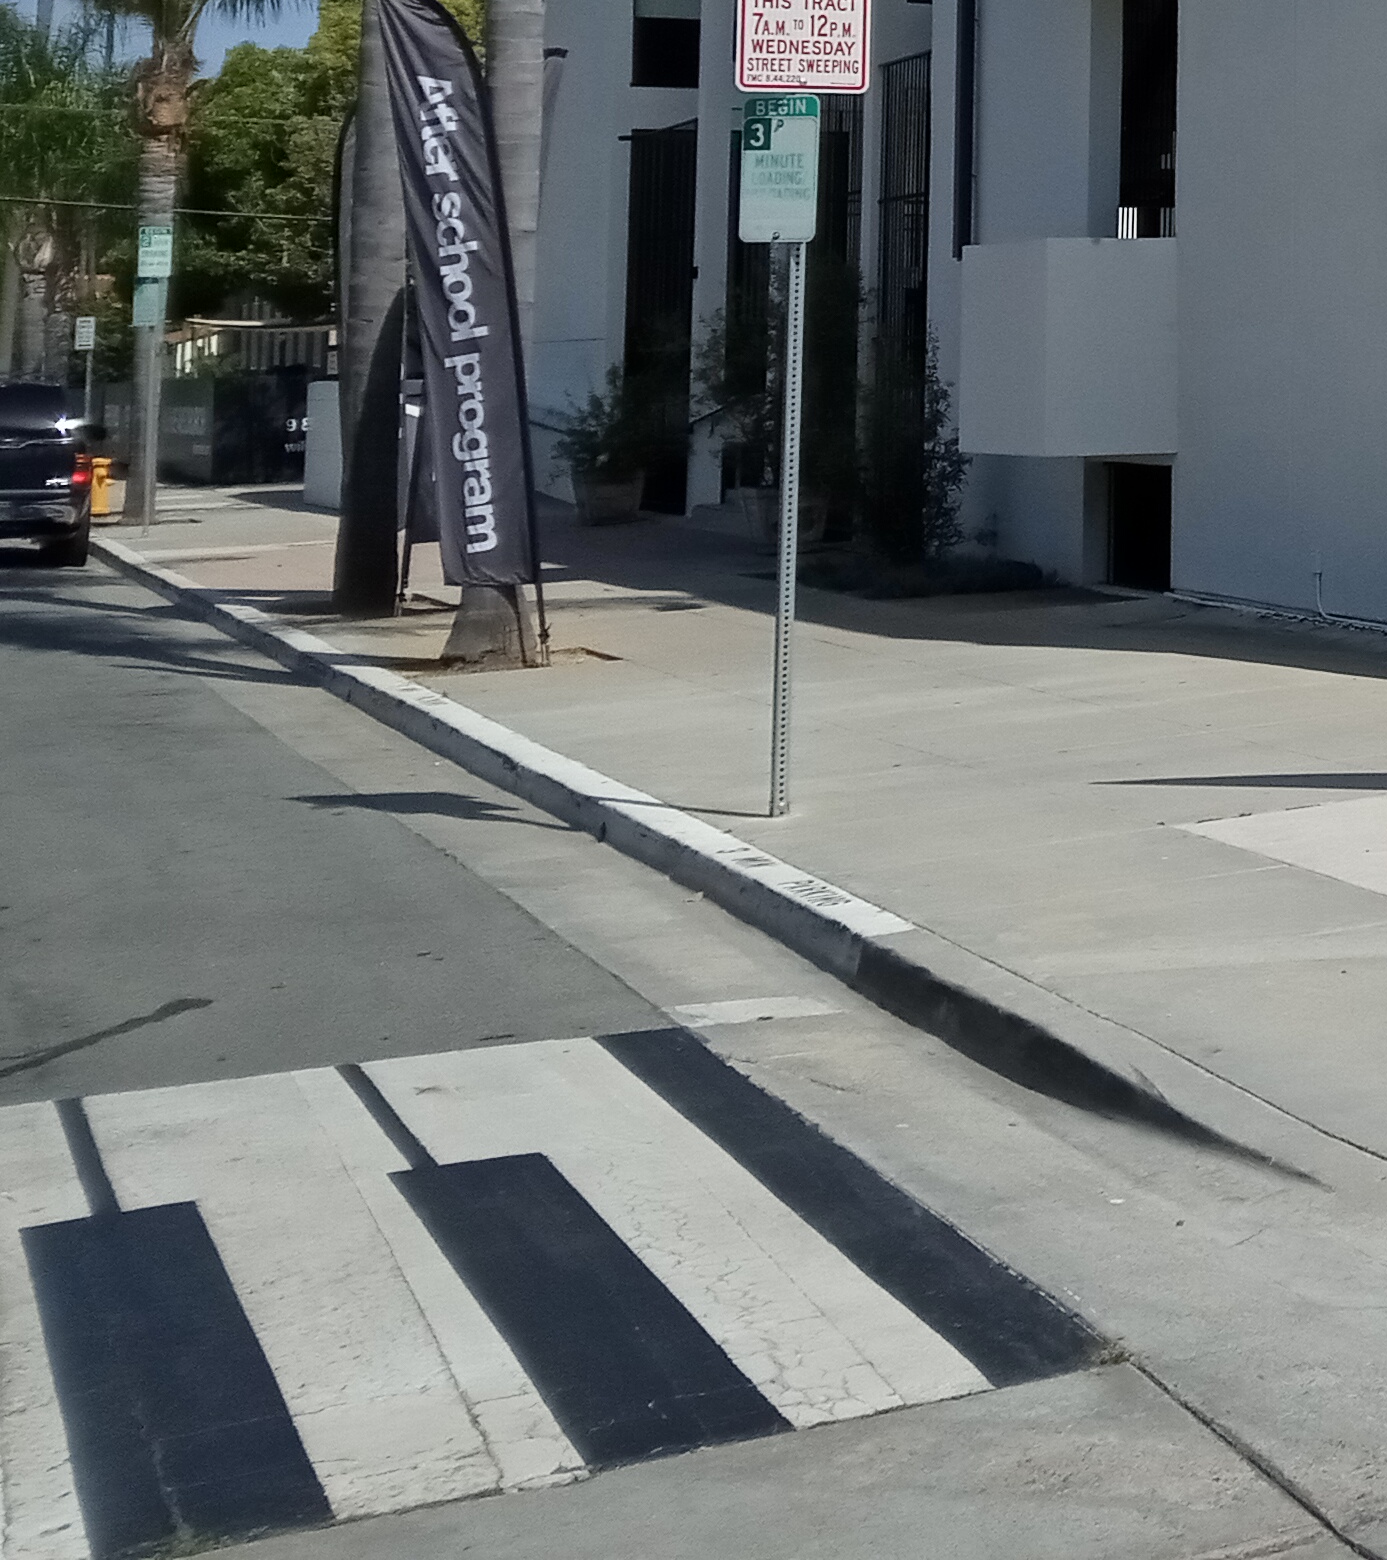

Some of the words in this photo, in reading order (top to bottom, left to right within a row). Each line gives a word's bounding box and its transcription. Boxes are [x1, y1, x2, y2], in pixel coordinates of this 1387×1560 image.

[793, 19, 804, 31] TO
[751, 38, 856, 56] WEDNESDAY
[746, 57, 793, 73] STREET
[798, 59, 860, 75] SWEEPING
[755, 97, 808, 117] BEGIN
[417, 75, 460, 182] After
[749, 123, 765, 147] 3
[754, 152, 805, 170] MINUTE
[431, 191, 490, 343] school
[444, 352, 498, 555] program
